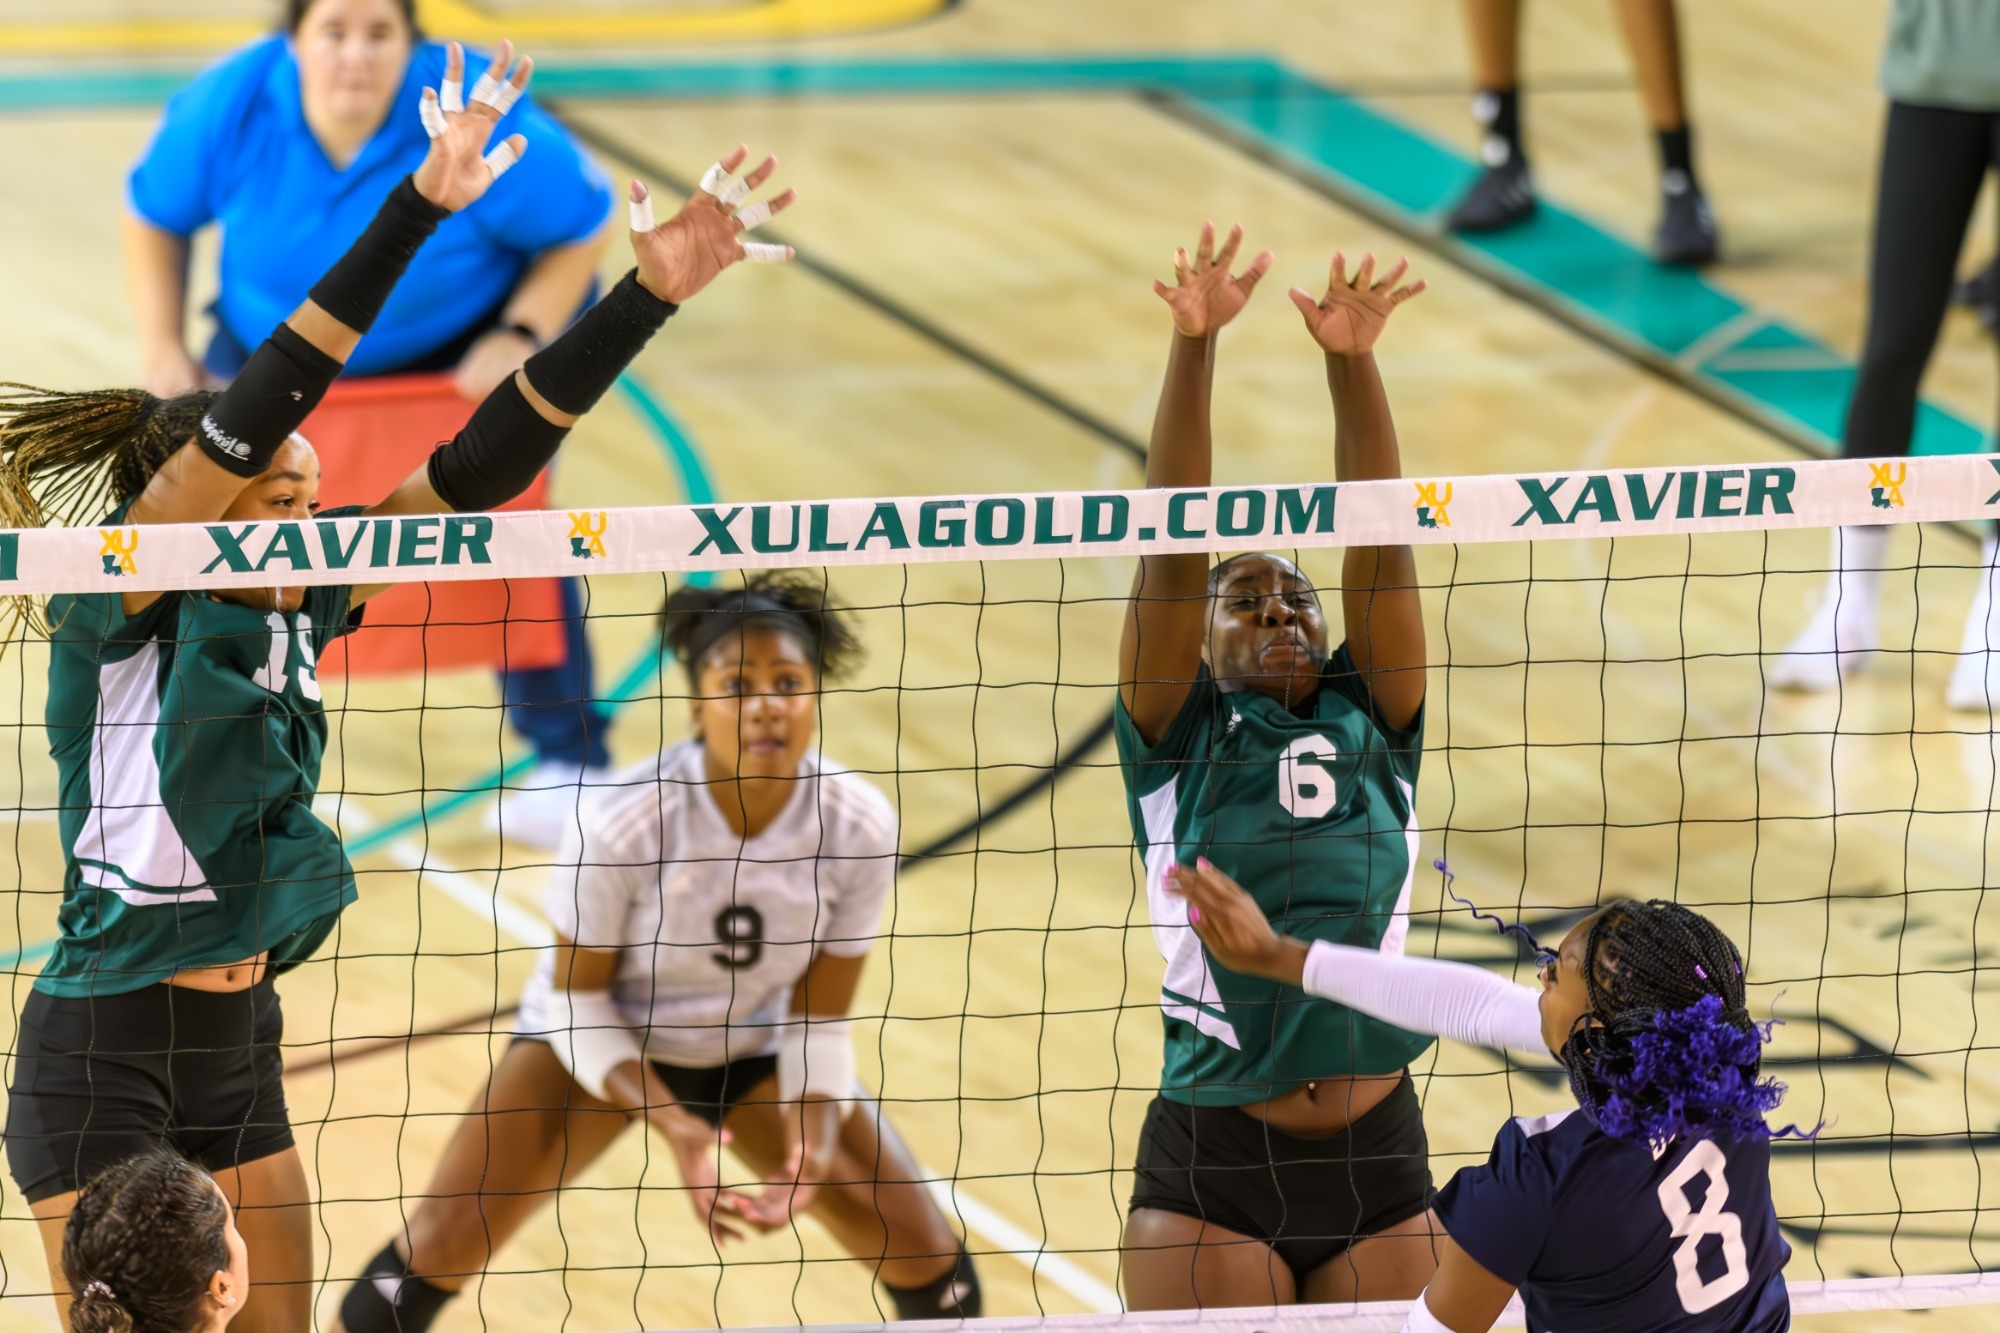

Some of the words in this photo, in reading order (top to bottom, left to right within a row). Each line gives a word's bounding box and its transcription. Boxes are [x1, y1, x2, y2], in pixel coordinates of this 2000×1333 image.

[688, 486, 1337, 556] XULAGOLD.COM
[1511, 467, 1797, 526] XAVIER
[200, 516, 493, 574] XAVIER
[1278, 733, 1337, 819] 6
[712, 904, 764, 972] 9
[1657, 1138, 1750, 1315] 8
